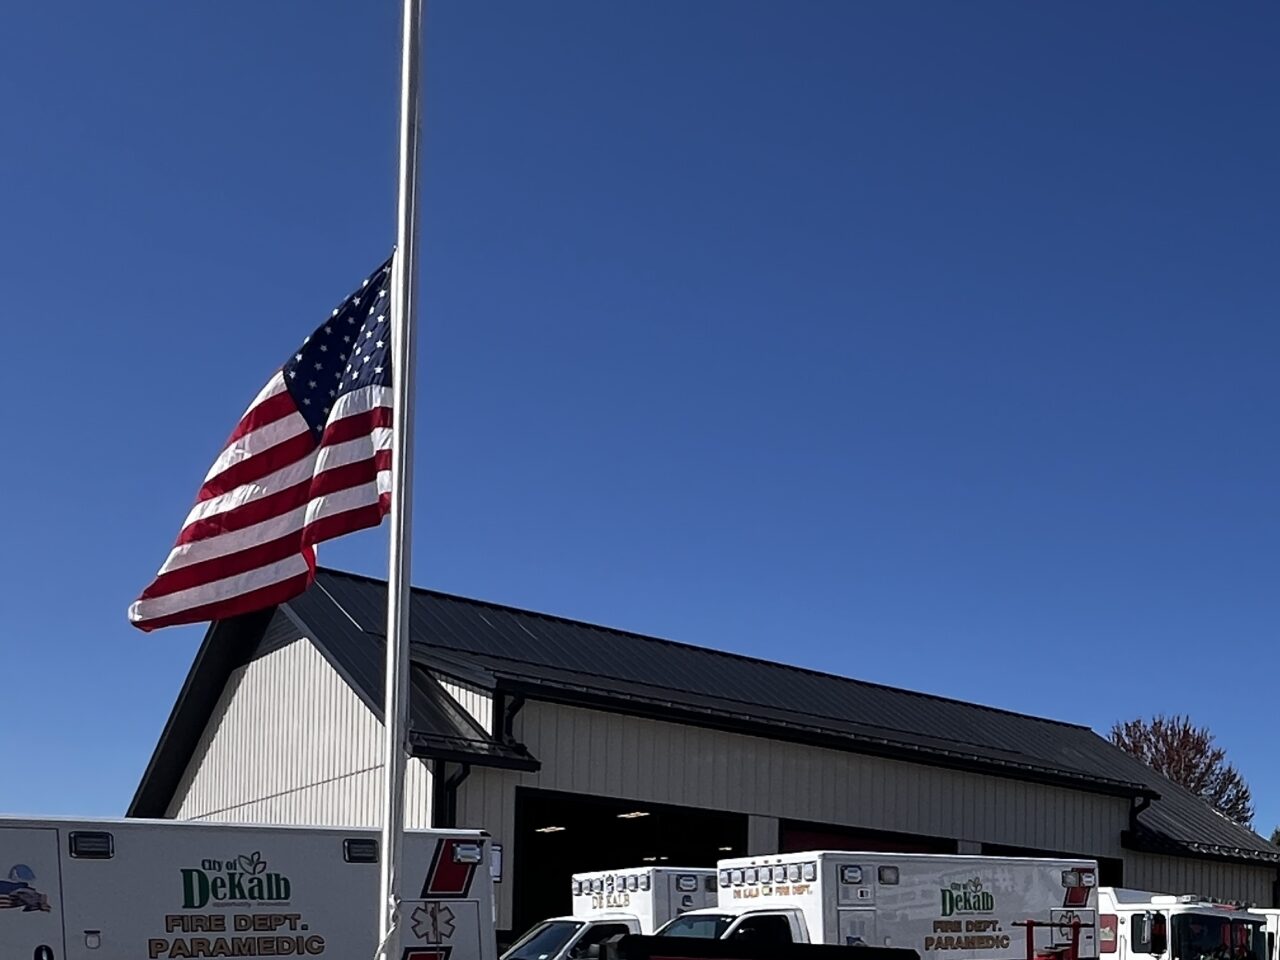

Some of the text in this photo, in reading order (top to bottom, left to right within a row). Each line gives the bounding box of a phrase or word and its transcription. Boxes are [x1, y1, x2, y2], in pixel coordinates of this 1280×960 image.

[225, 859, 237, 871] of
[180, 868, 291, 909] DeKalb
[941, 888, 994, 917] DeKalb
[165, 913, 309, 933] FIRE DEPT.
[966, 920, 1002, 932] DEPT.
[148, 935, 325, 959] PARAMEDIC
[924, 935, 1010, 951] PARAMEDIC
